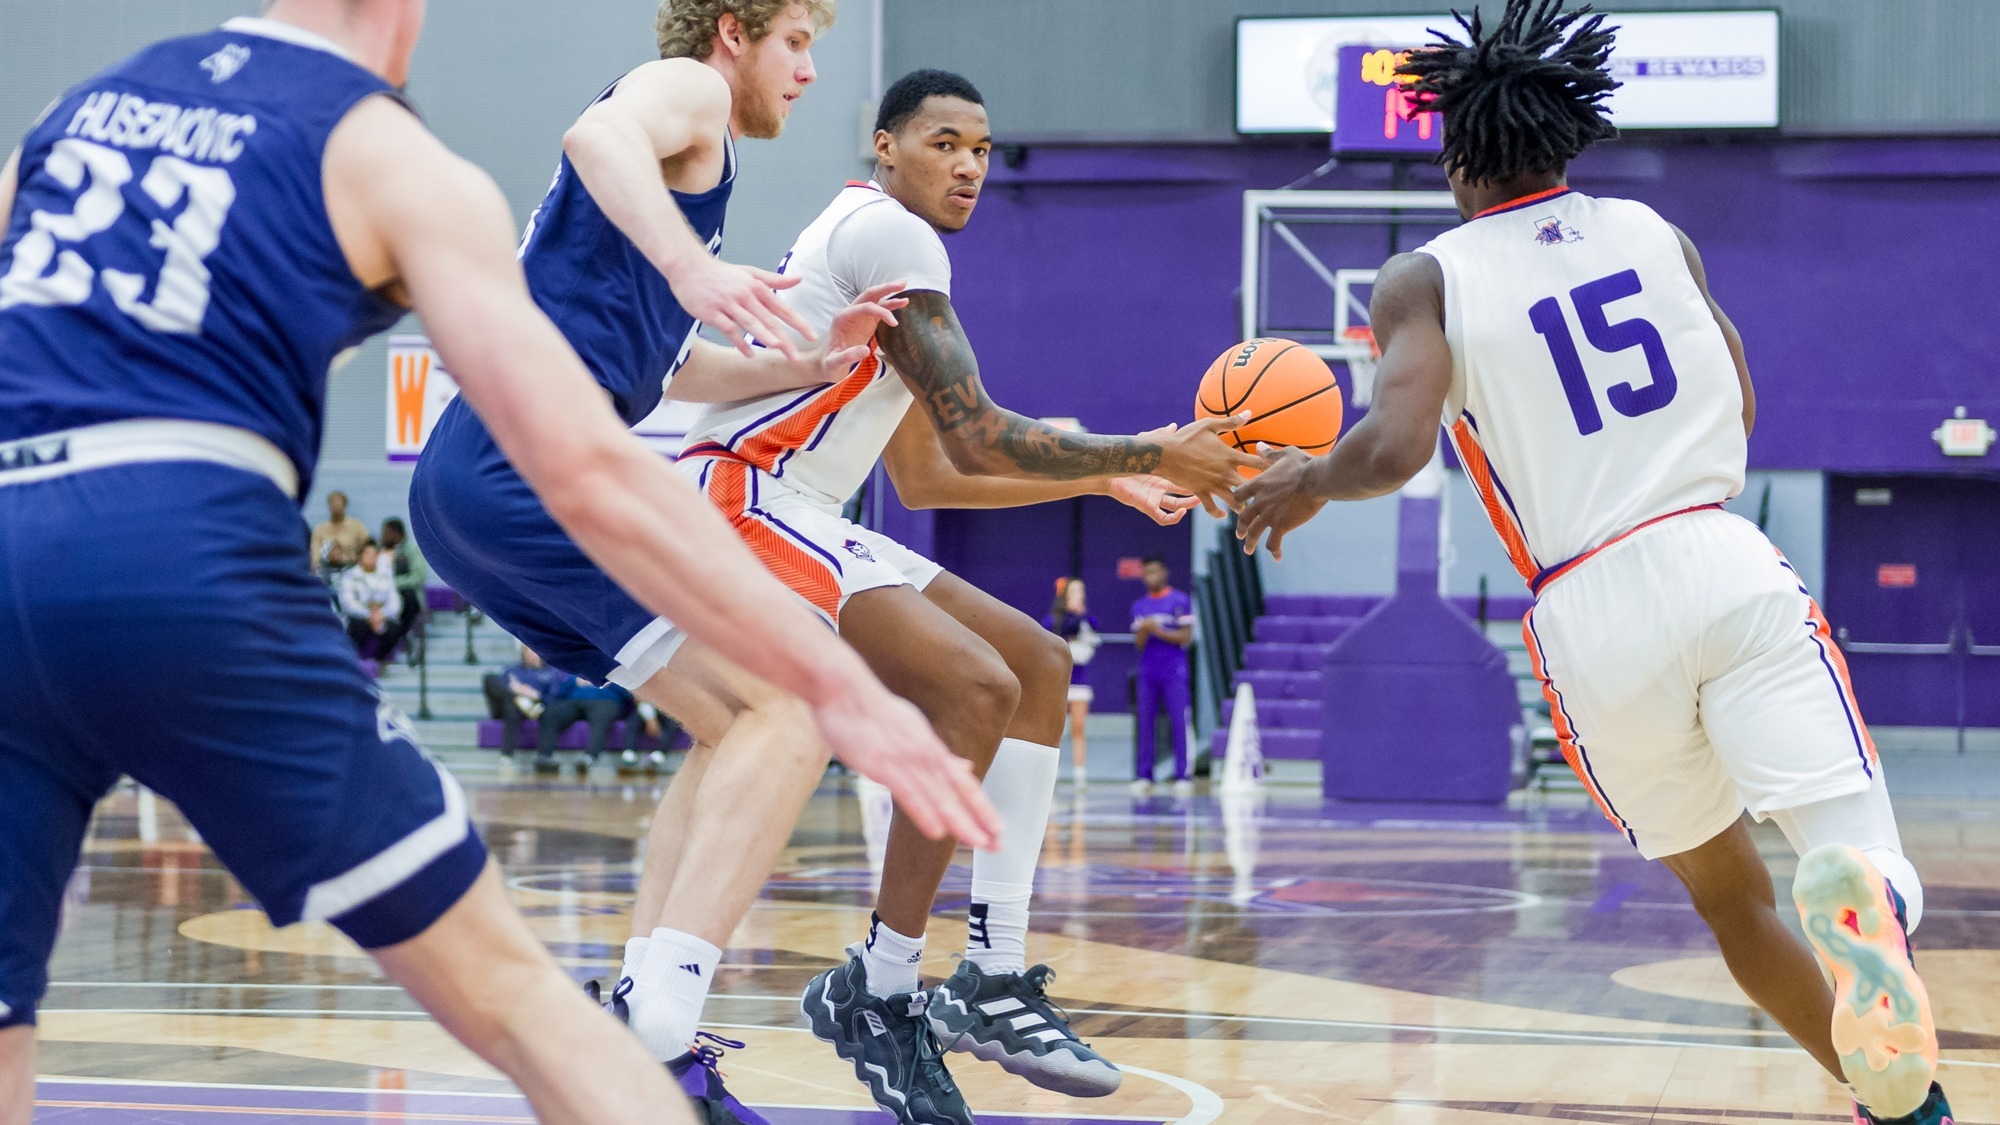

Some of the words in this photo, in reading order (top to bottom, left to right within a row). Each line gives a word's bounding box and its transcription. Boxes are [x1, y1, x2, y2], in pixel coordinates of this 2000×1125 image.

[1648, 56, 1765, 78] REWARDS
[0, 138, 237, 337] 23
[394, 353, 429, 444] W
[1528, 268, 1678, 436] 15
